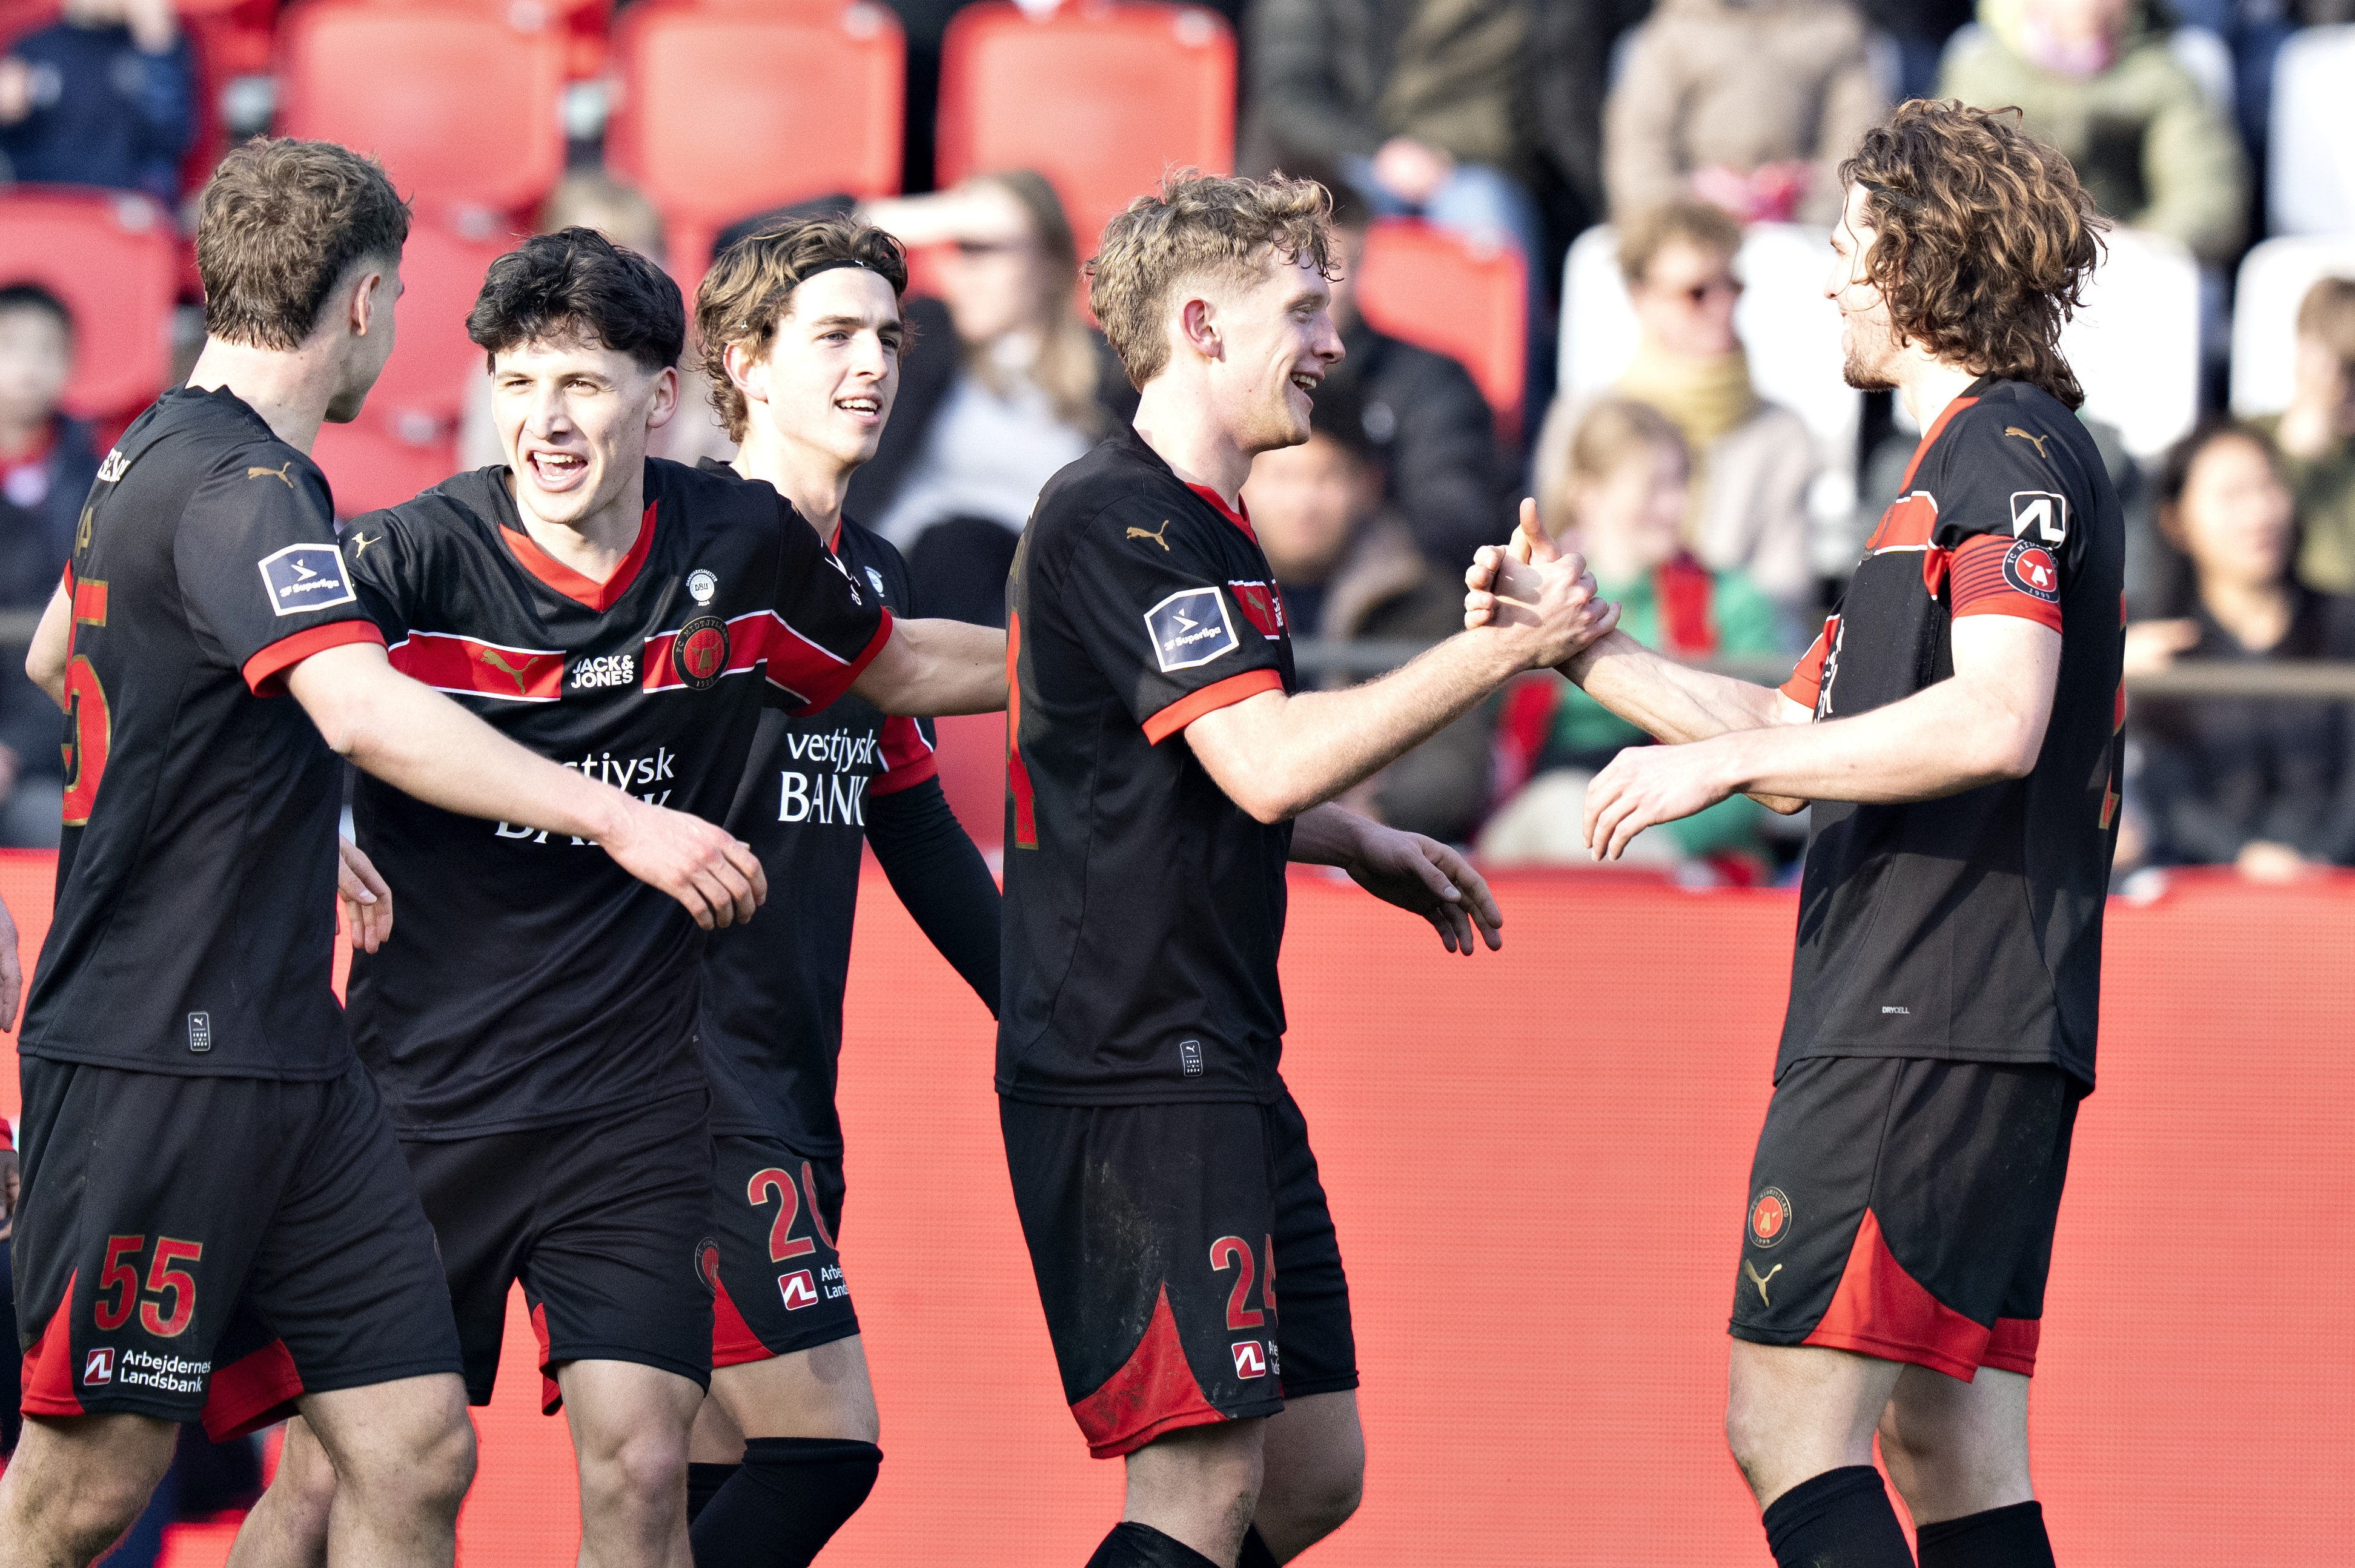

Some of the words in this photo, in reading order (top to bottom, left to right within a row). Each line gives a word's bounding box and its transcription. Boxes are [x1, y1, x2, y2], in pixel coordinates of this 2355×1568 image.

[2007, 552, 2017, 563] FC
[292, 578, 340, 594] Superliga
[695, 583, 709, 591] DBU
[2029, 587, 2051, 600] 1999
[1175, 626, 1222, 646] Superliga
[676, 641, 684, 653] FC
[572, 655, 634, 674] JACK&
[571, 669, 634, 689] JONES
[787, 727, 876, 773] vestjysk
[777, 771, 869, 826] BANK
[94, 1234, 203, 1338] 55
[122, 1349, 211, 1375] Arbejdernes
[120, 1367, 203, 1393] Landsbank
